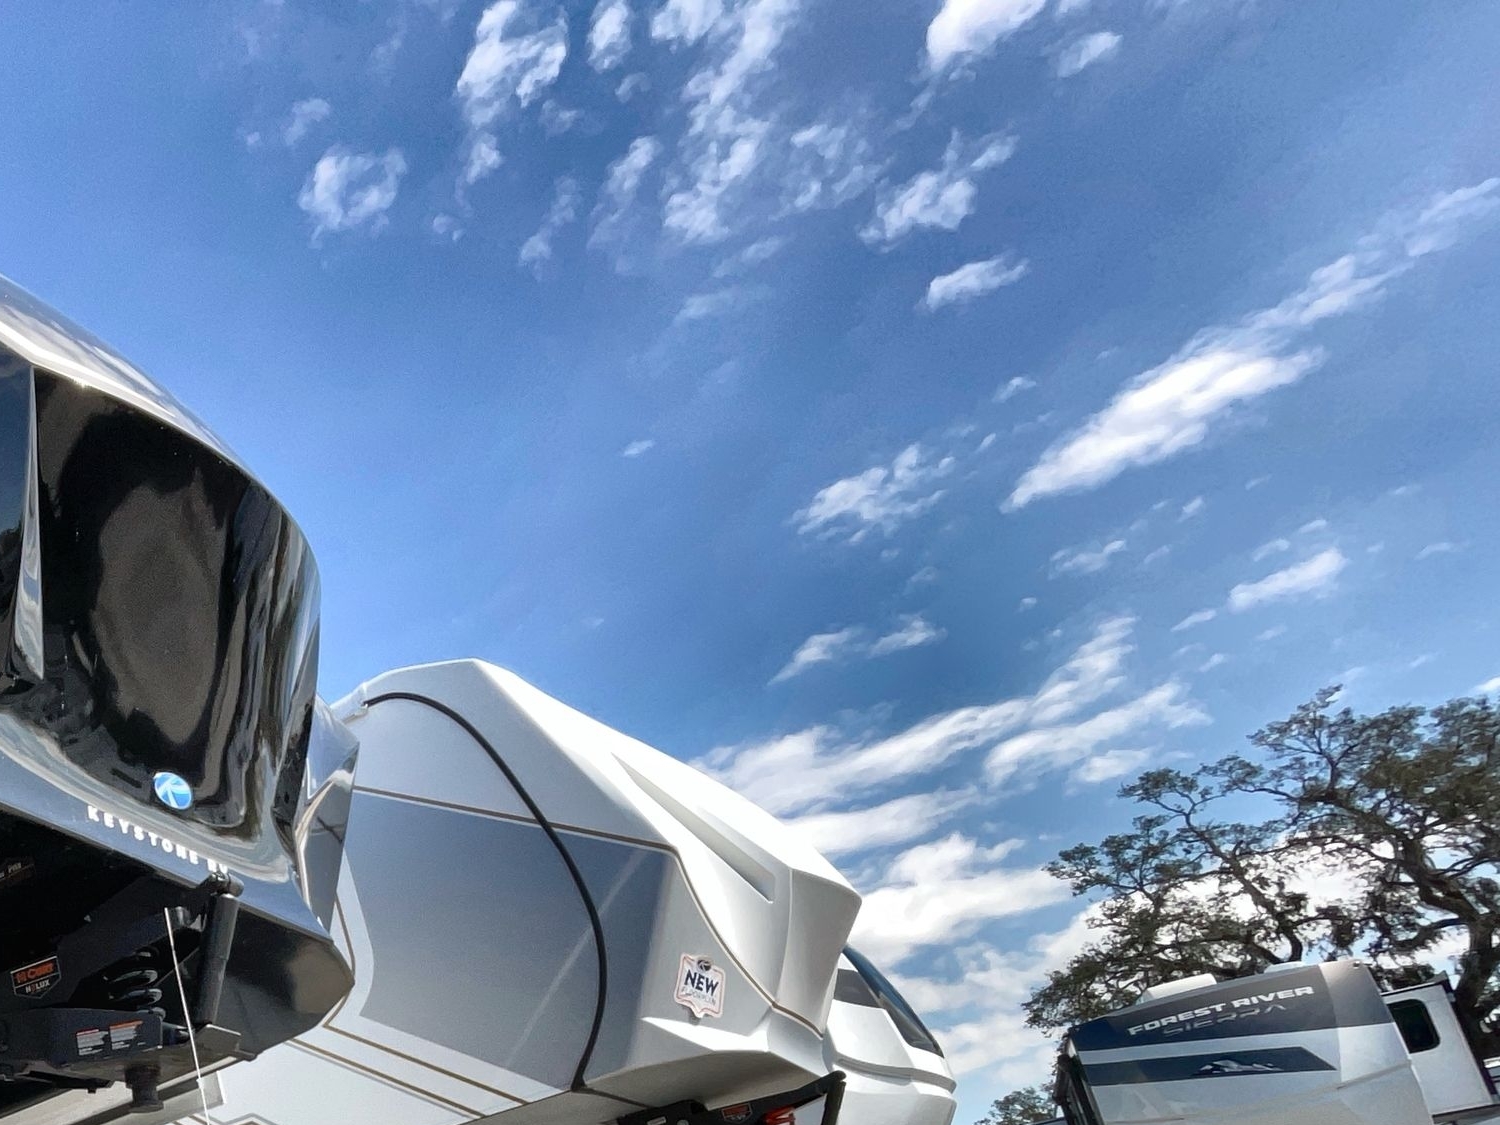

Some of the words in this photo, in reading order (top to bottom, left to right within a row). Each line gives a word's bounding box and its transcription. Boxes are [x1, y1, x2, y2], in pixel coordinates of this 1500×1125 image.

[87, 804, 200, 865] KEYSTONE
[684, 969, 719, 997] NEW
[1127, 1002, 1228, 1036] FOREST
[1231, 985, 1315, 1008] RIVER
[1162, 1003, 1288, 1037] SIERRA
